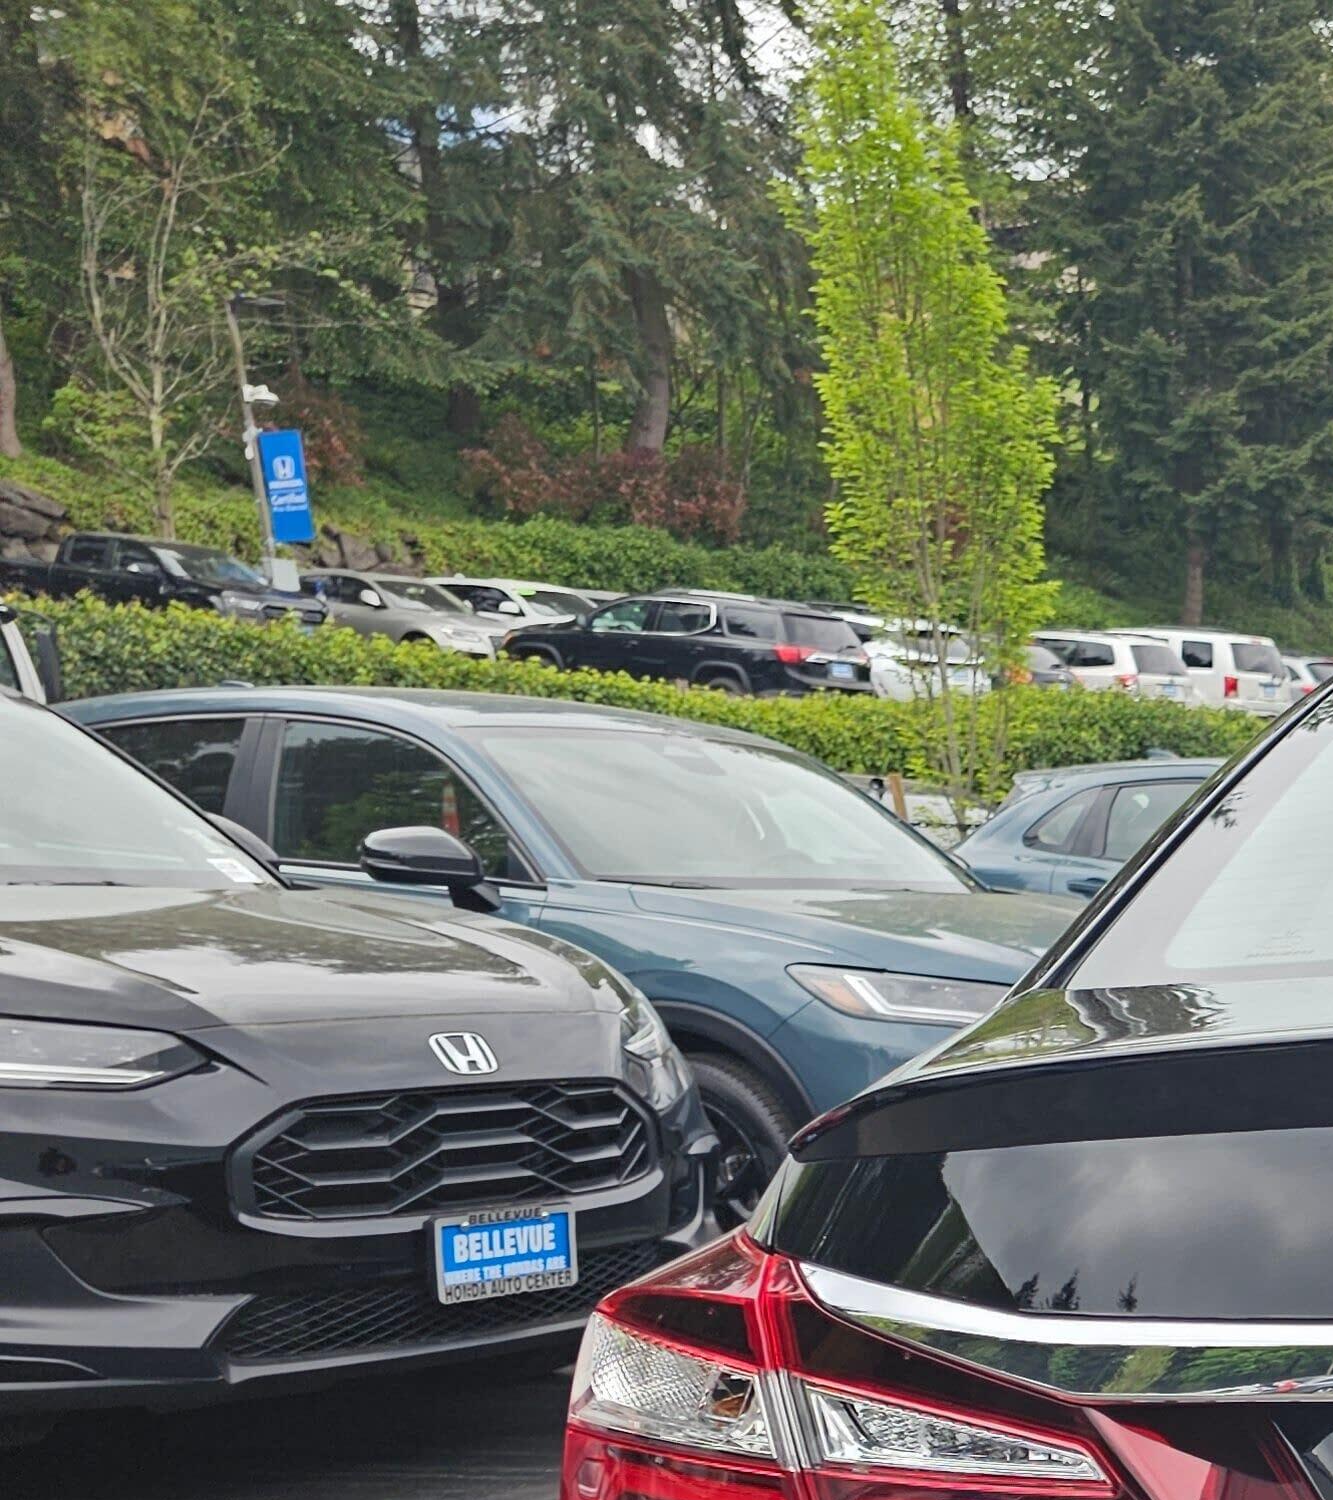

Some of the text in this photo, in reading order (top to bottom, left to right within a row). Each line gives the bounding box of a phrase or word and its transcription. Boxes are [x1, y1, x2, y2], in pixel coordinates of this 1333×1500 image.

[468, 1207, 543, 1225] BELLEVUE
[452, 1222, 556, 1264] BELLEVUE
[444, 1270, 572, 1301] HONDA AUTO CENTER
